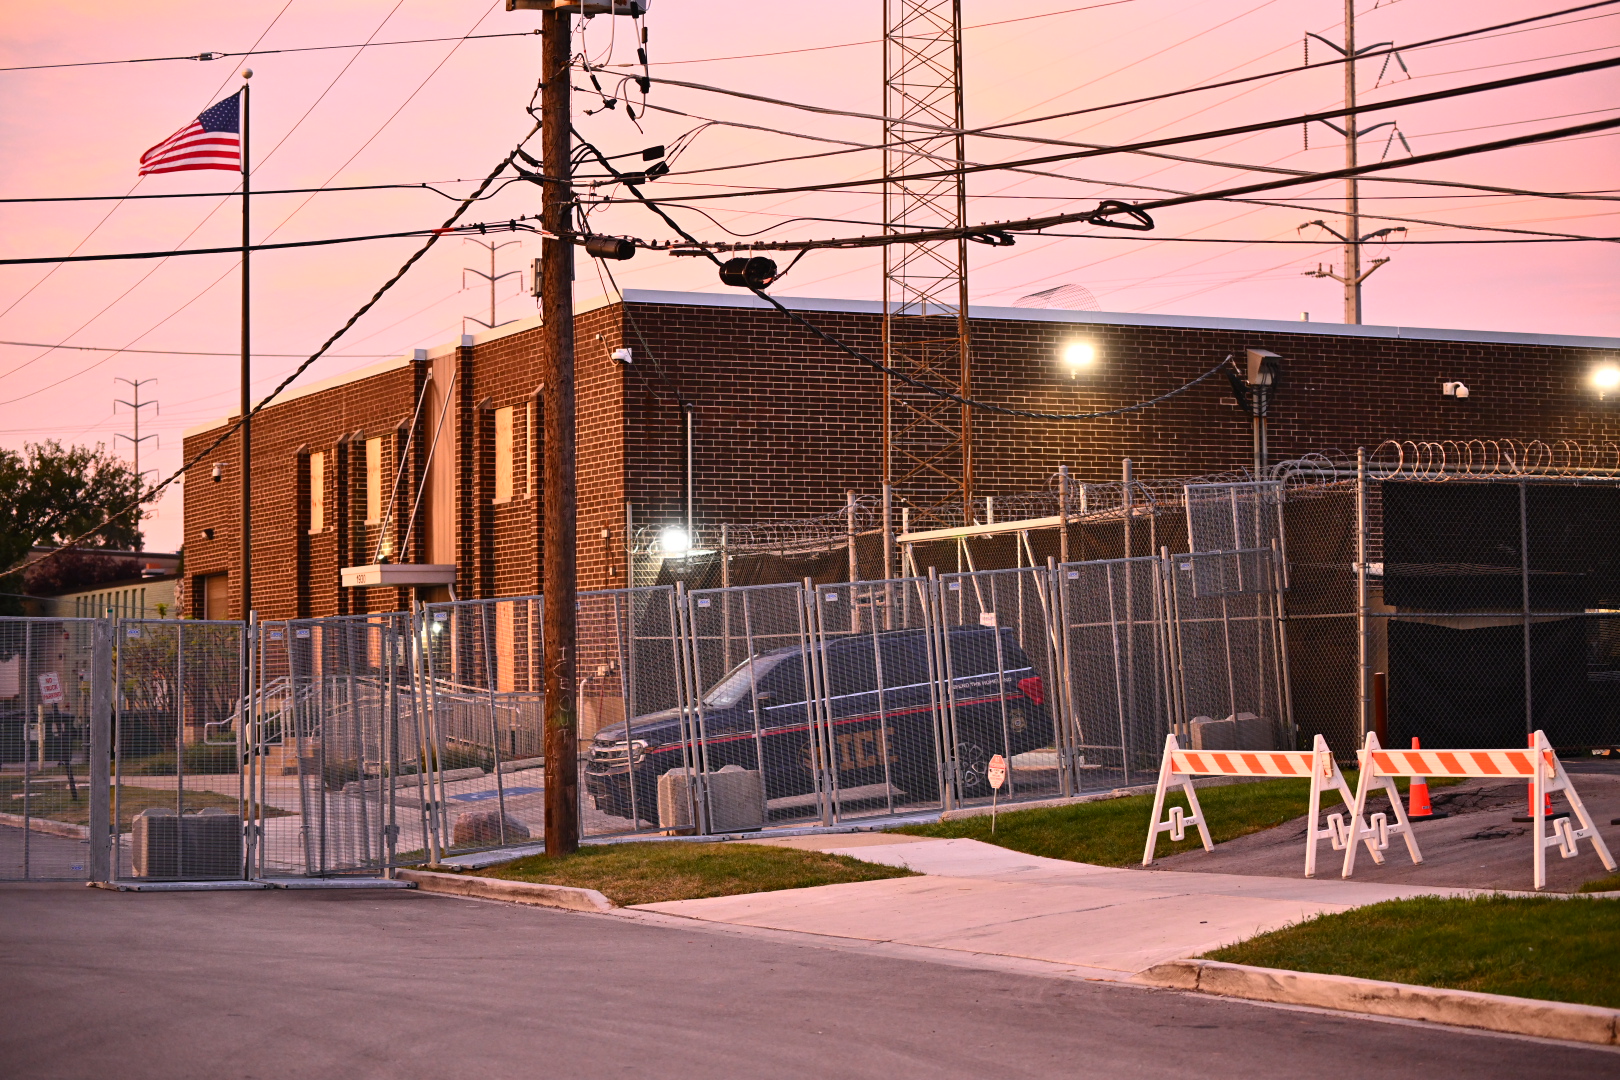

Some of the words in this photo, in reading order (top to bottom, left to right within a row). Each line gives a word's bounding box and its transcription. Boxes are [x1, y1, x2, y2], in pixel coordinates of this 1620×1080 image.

[553, 646, 570, 690] ICE
[982, 677, 1012, 685] HOMELND
[43, 692, 62, 700] PARKING
[836, 727, 899, 771] ICE
